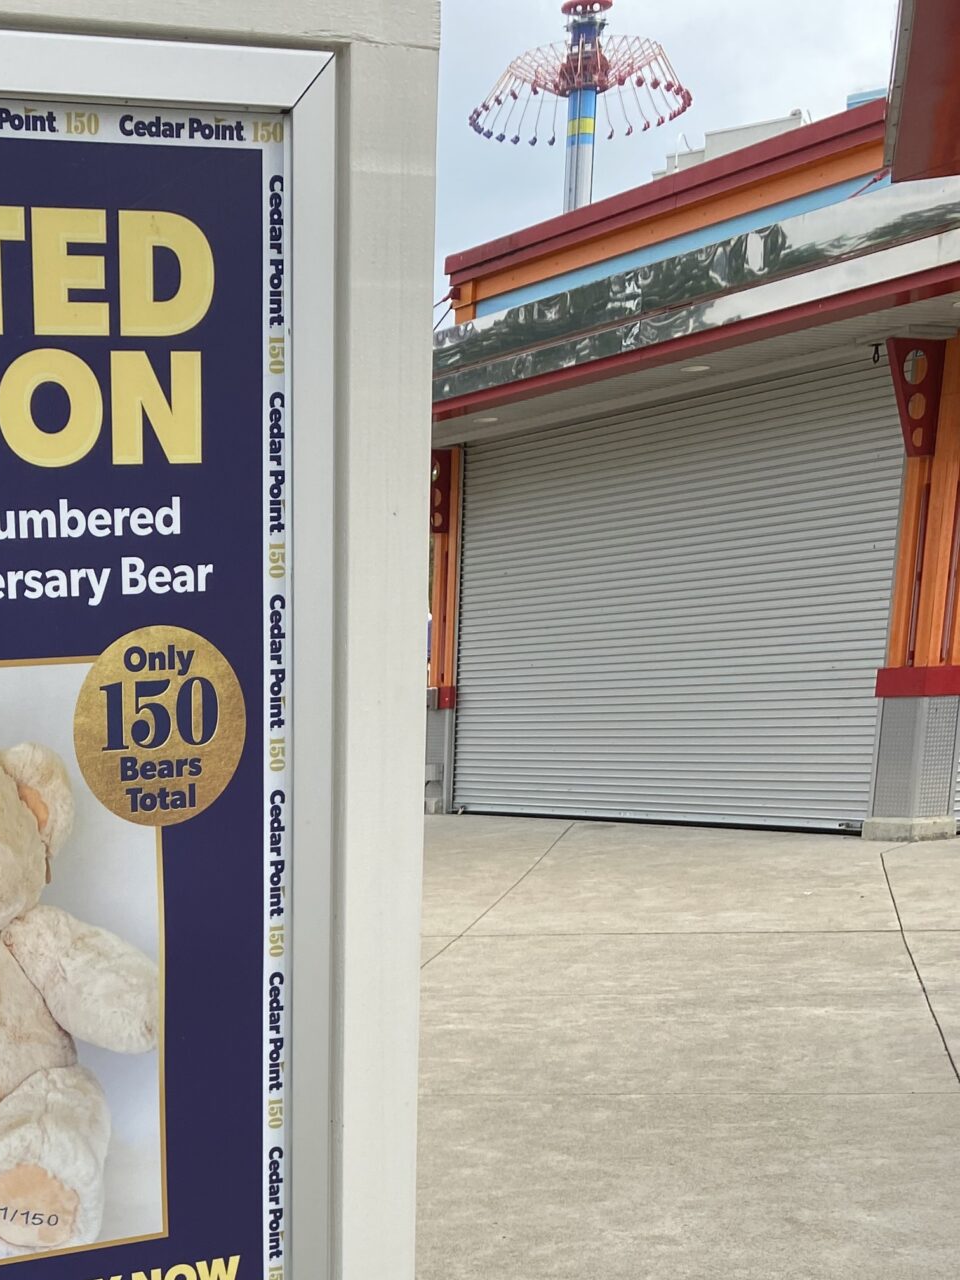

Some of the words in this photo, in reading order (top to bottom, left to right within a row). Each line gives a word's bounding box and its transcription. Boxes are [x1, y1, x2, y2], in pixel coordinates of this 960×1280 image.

[65, 112, 99, 135] 150
[119, 115, 185, 139] Cedar
[188, 117, 244, 141] Point
[252, 121, 283, 143] 150
[269, 175, 284, 254] Cedar
[269, 259, 284, 327] Point
[268, 336, 285, 375] 150
[269, 391, 285, 466] Cedar
[269, 470, 285, 533] Point
[121, 556, 213, 595] Bear
[268, 543, 285, 579] 150
[269, 594, 285, 665] Cedar
[124, 645, 195, 675] Only
[99, 676, 219, 751] 150
[270, 668, 285, 729] Point
[120, 756, 202, 782] Bears
[269, 736, 285, 772] 150
[126, 784, 196, 812] Total
[270, 789, 285, 856] Cedar
[270, 860, 285, 917] Point
[269, 924, 284, 957] 150
[269, 971, 284, 1034] Cedar
[268, 1037, 284, 1092] Point
[268, 1098, 283, 1128] 150
[268, 1146, 283, 1205] Cedar
[269, 1208, 284, 1259] Point
